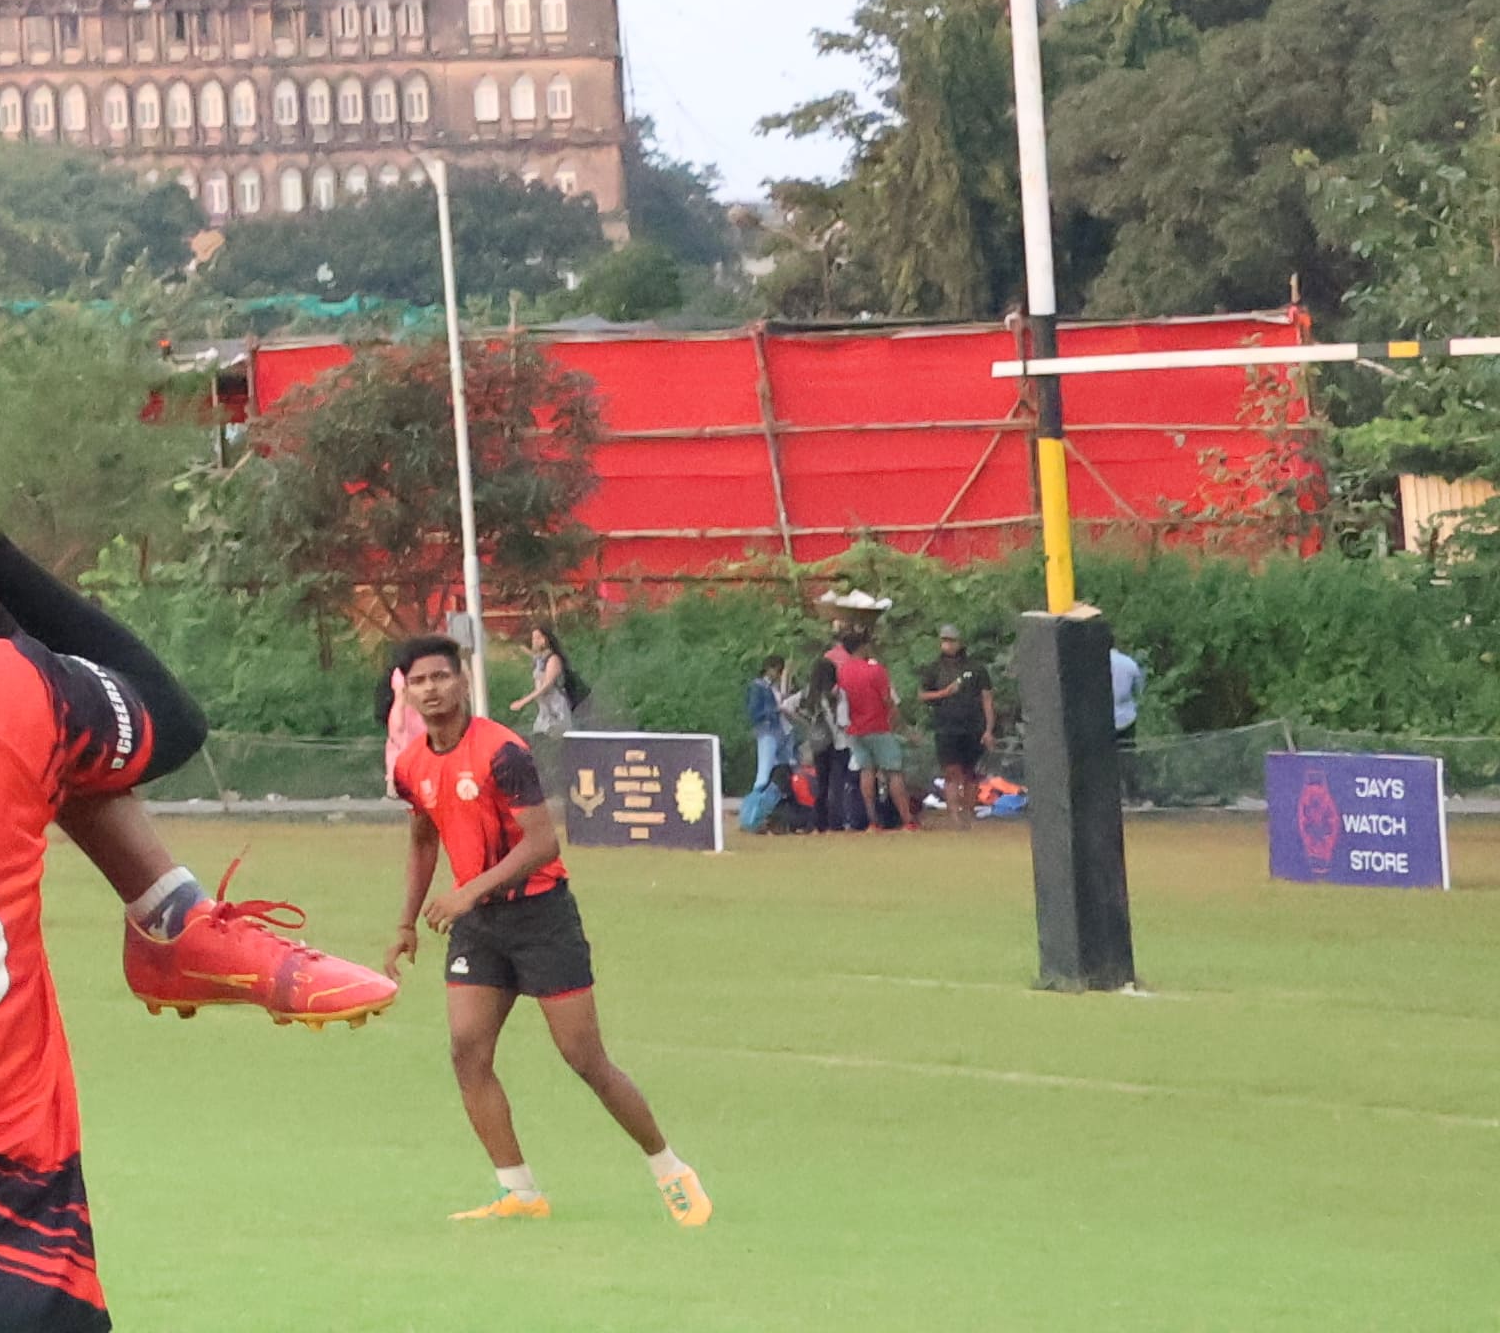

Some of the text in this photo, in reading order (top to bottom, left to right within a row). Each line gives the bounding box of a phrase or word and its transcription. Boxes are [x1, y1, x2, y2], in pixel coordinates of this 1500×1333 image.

[1355, 777, 1404, 799] JAYS
[1342, 813, 1406, 836] WATCH
[1350, 849, 1409, 874] STORE
